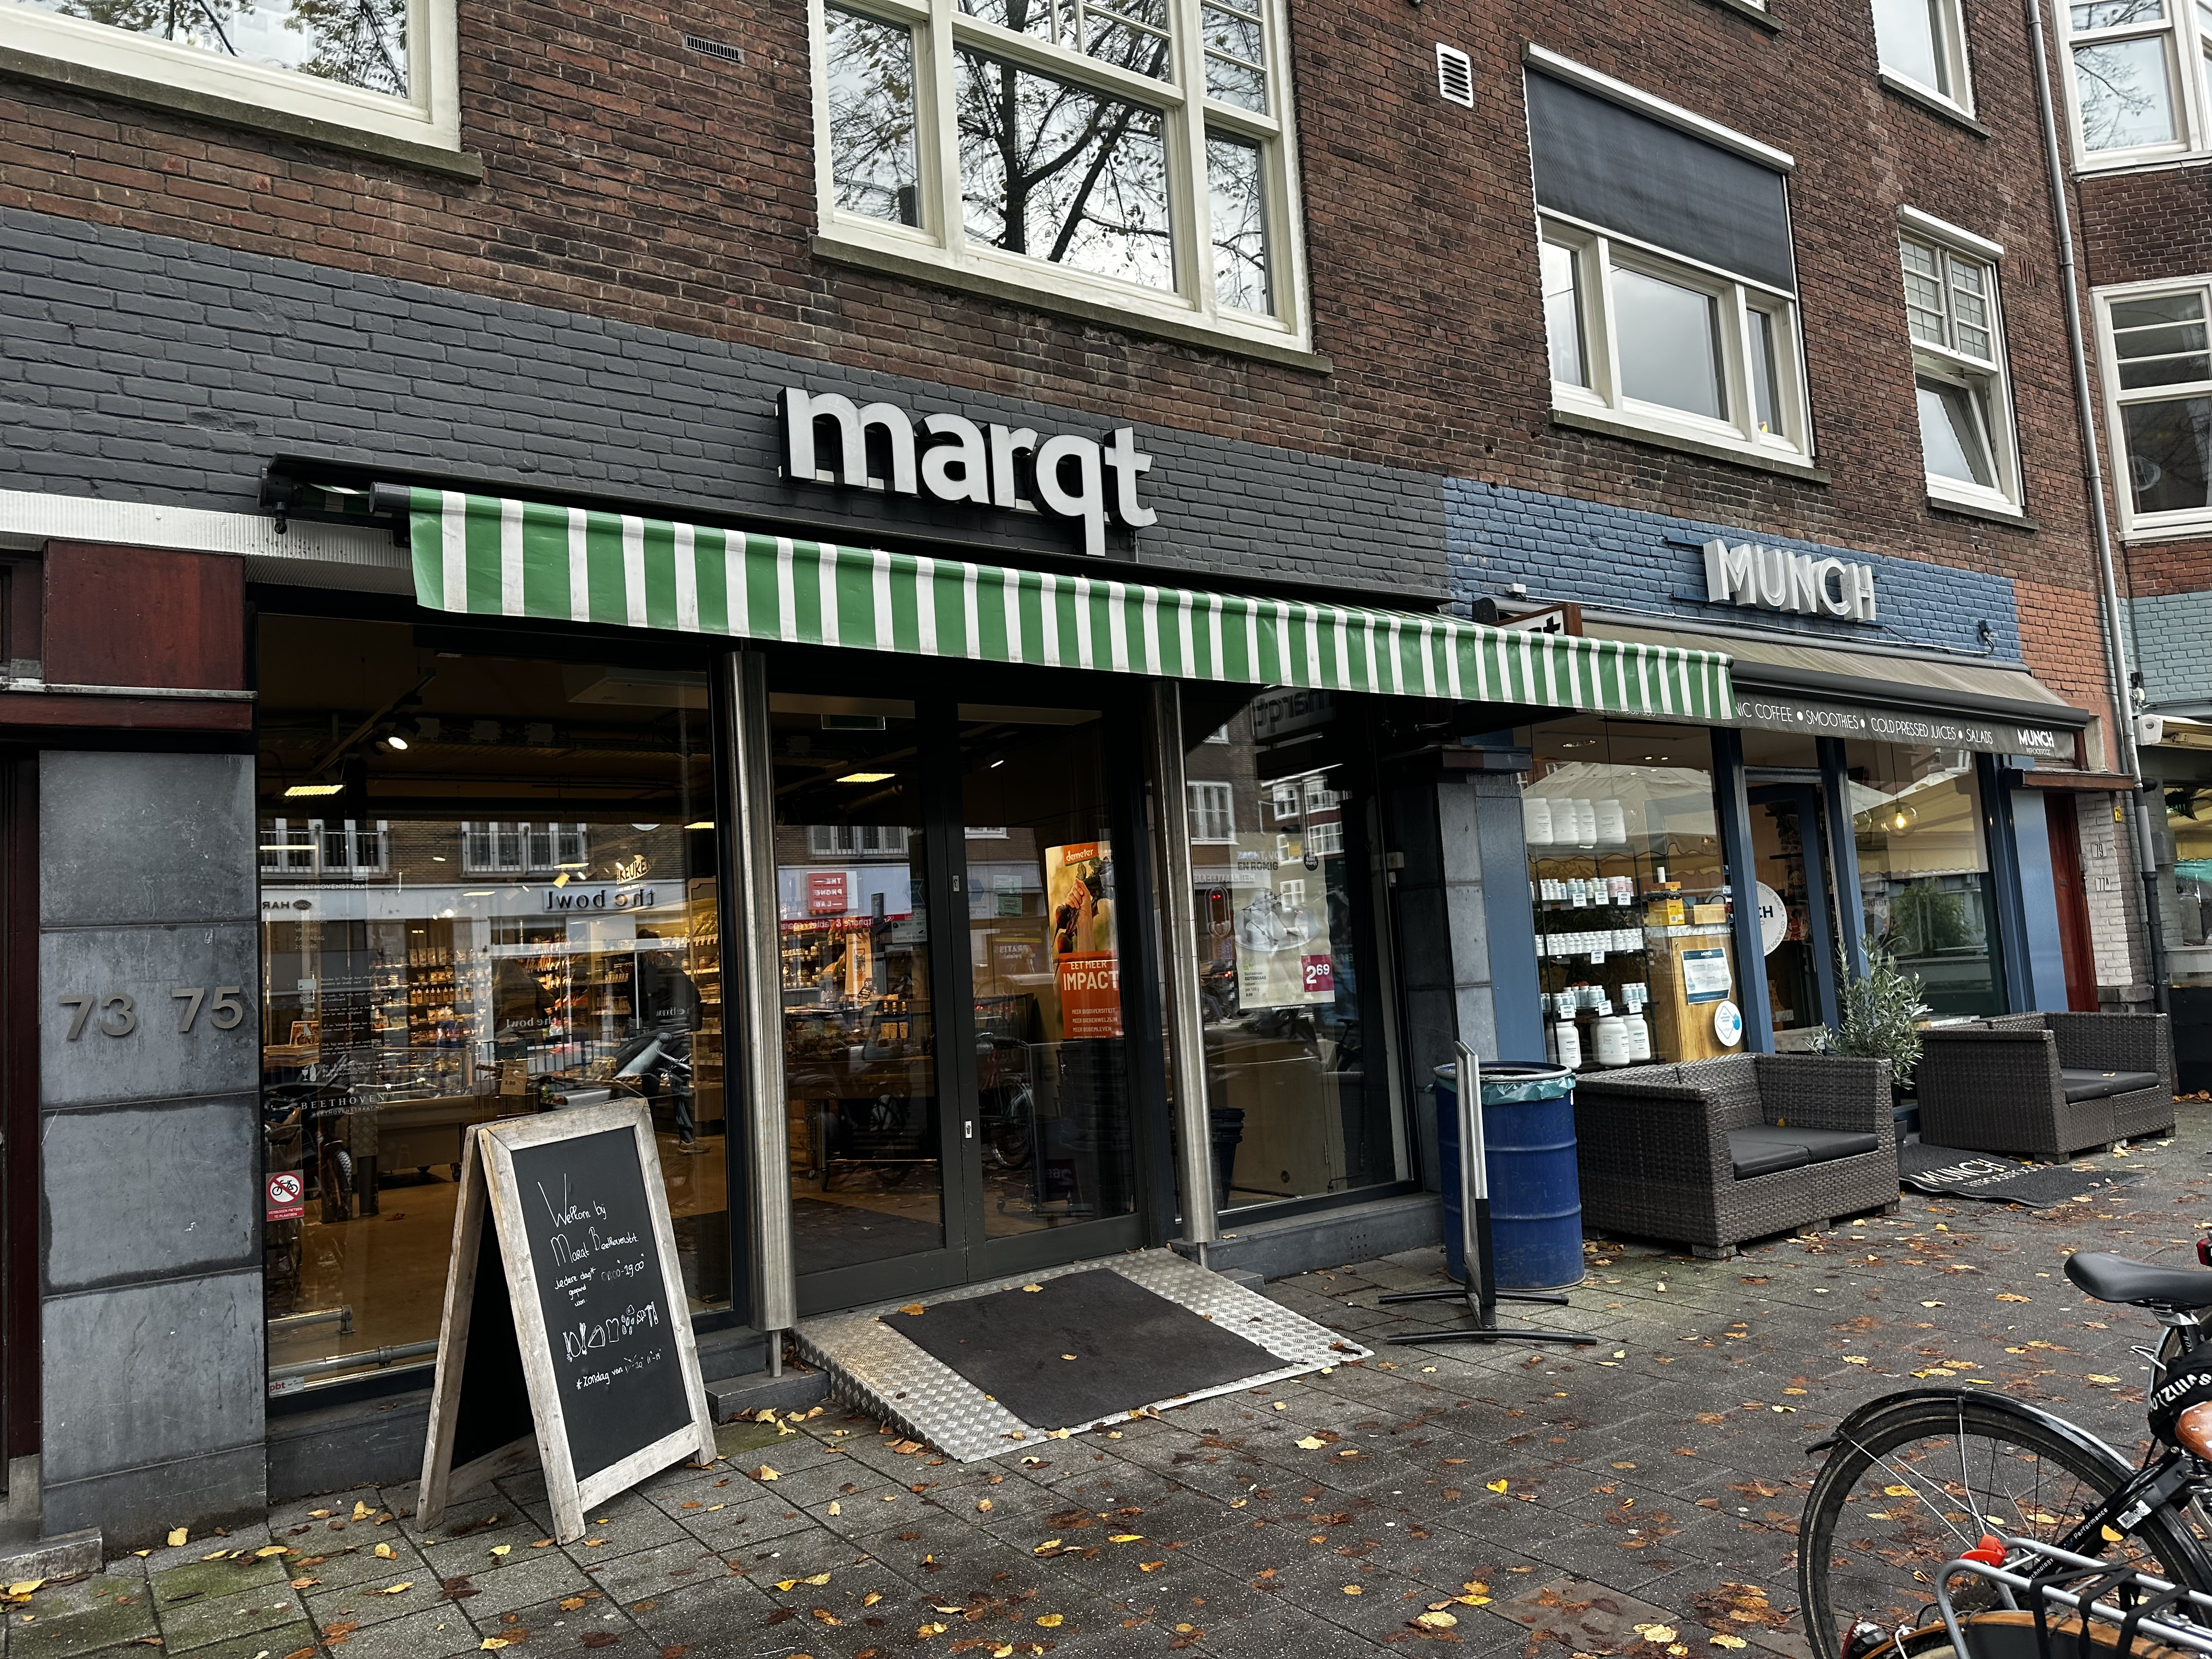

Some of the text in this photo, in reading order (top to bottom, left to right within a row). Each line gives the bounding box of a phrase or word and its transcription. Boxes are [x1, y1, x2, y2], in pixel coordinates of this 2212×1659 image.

[778, 386, 1159, 557] marqt
[1703, 539, 1876, 623] MUNCH
[1755, 703, 1793, 723] COFFEE
[1806, 709, 1859, 730] SMOOTHIES
[1871, 717, 1895, 733] COLD
[1896, 720, 1928, 738] PRESSED
[1931, 725, 1956, 741] JUICES
[1966, 728, 1993, 744] SALADS
[2017, 728, 2055, 748] MUNCH
[1066, 849, 1093, 862] demeter
[2094, 843, 2104, 857] 79
[1237, 861, 1279, 871] EN ROMIG
[1070, 961, 1107, 970] EET MEER
[1063, 970, 1119, 991] IMPACT
[58, 985, 244, 1041] 73 75
[301, 1094, 385, 1110] BEETHOVEN
[1910, 1158, 2007, 1186] MUNCH
[537, 1173, 591, 1228] Welkom
[612, 1367, 623, 1376] van
[2074, 1507, 2108, 1539] Performance
[2027, 1558, 2054, 1581] echnology
